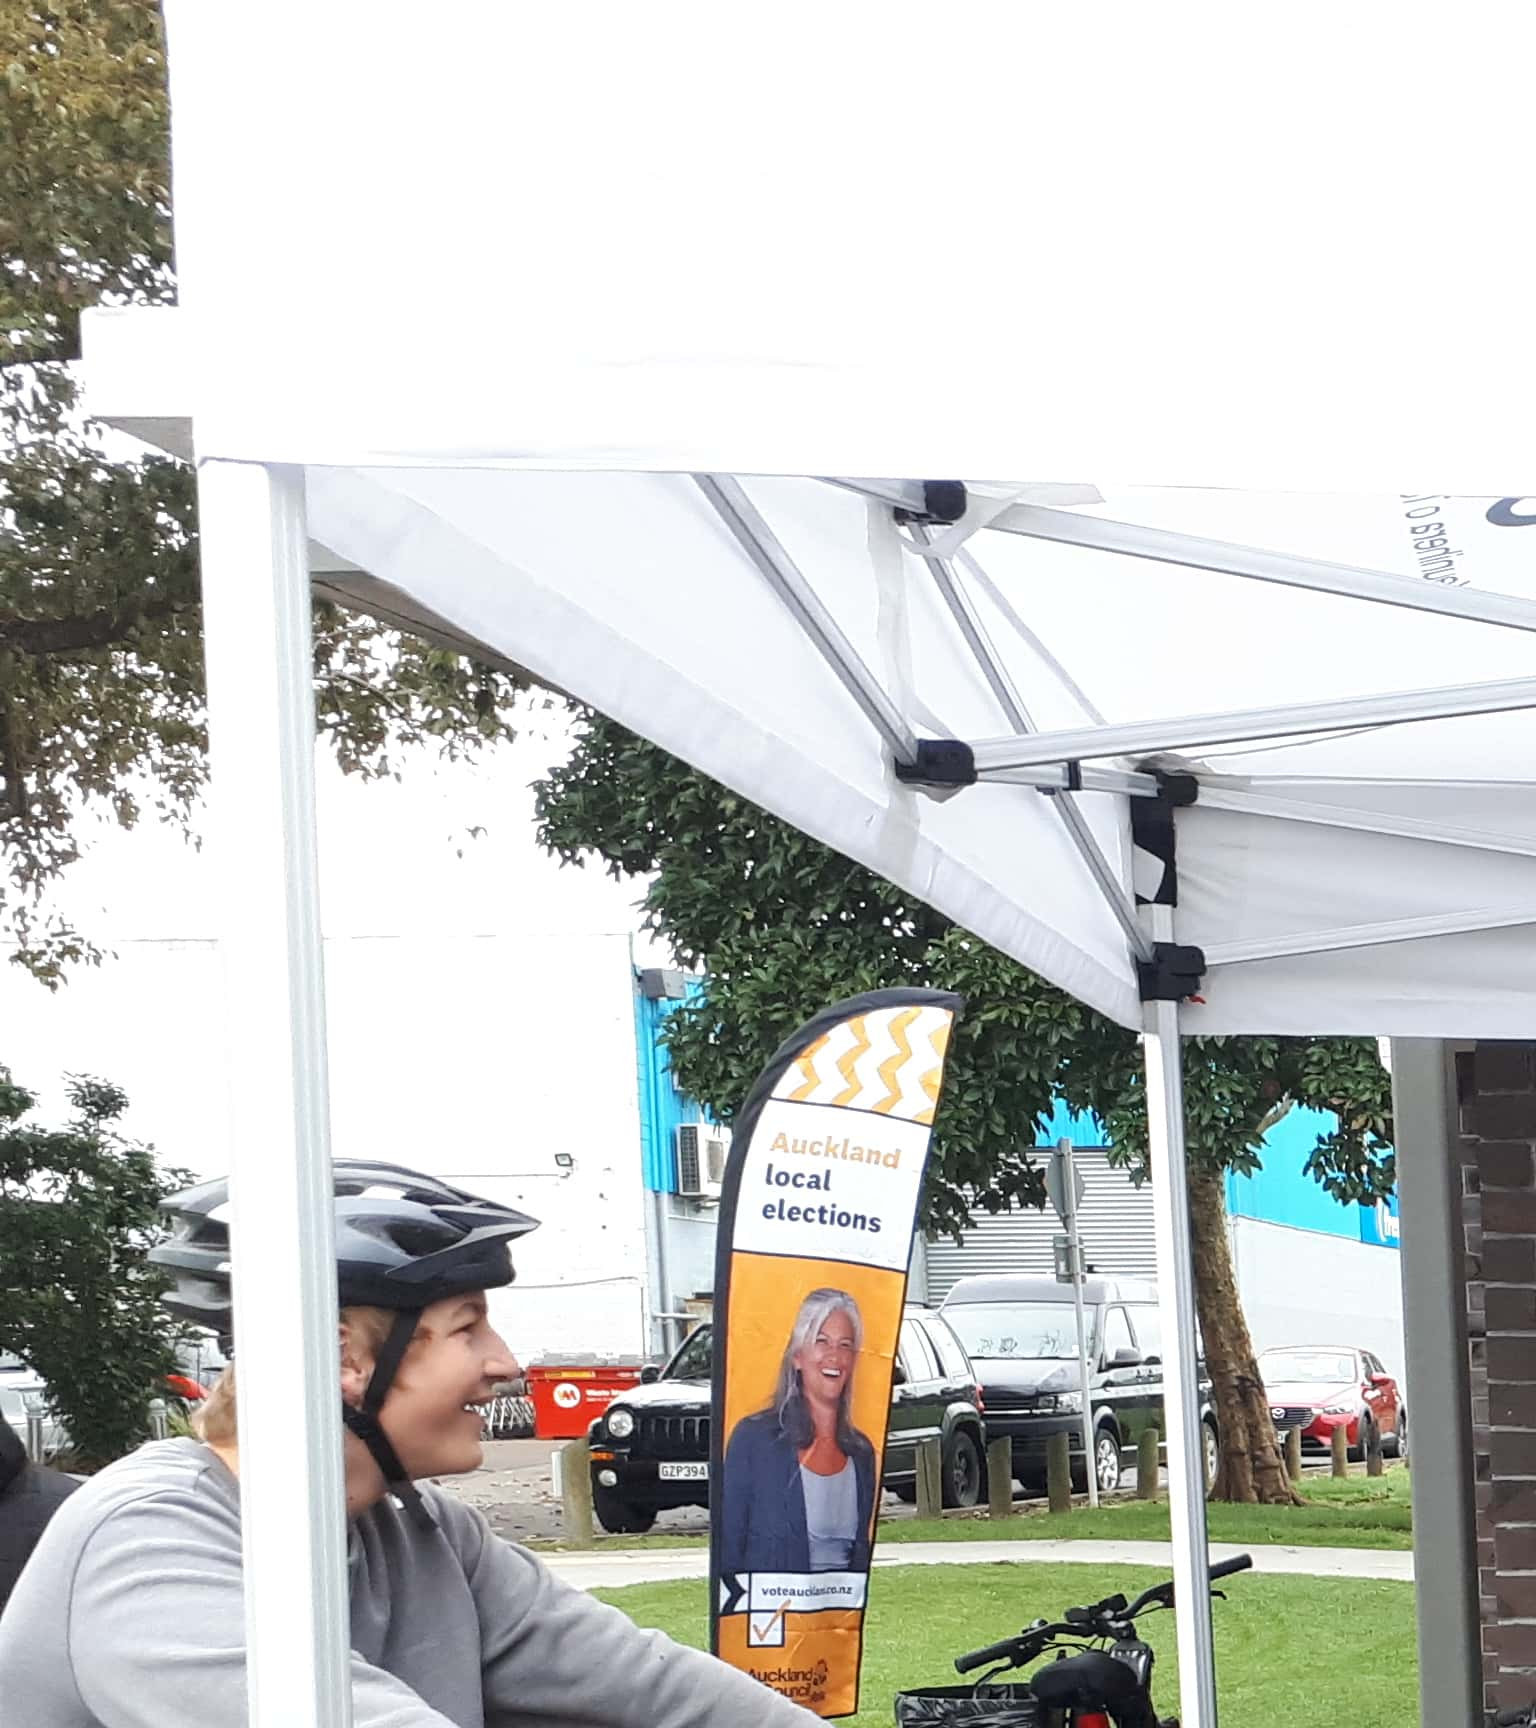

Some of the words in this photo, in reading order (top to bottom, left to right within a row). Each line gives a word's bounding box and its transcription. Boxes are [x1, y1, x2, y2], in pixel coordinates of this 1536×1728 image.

[769, 1132, 902, 1170] Auckland
[765, 1163, 832, 1192] local
[762, 1199, 883, 1233] elections
[660, 1464, 707, 1478] GZP394
